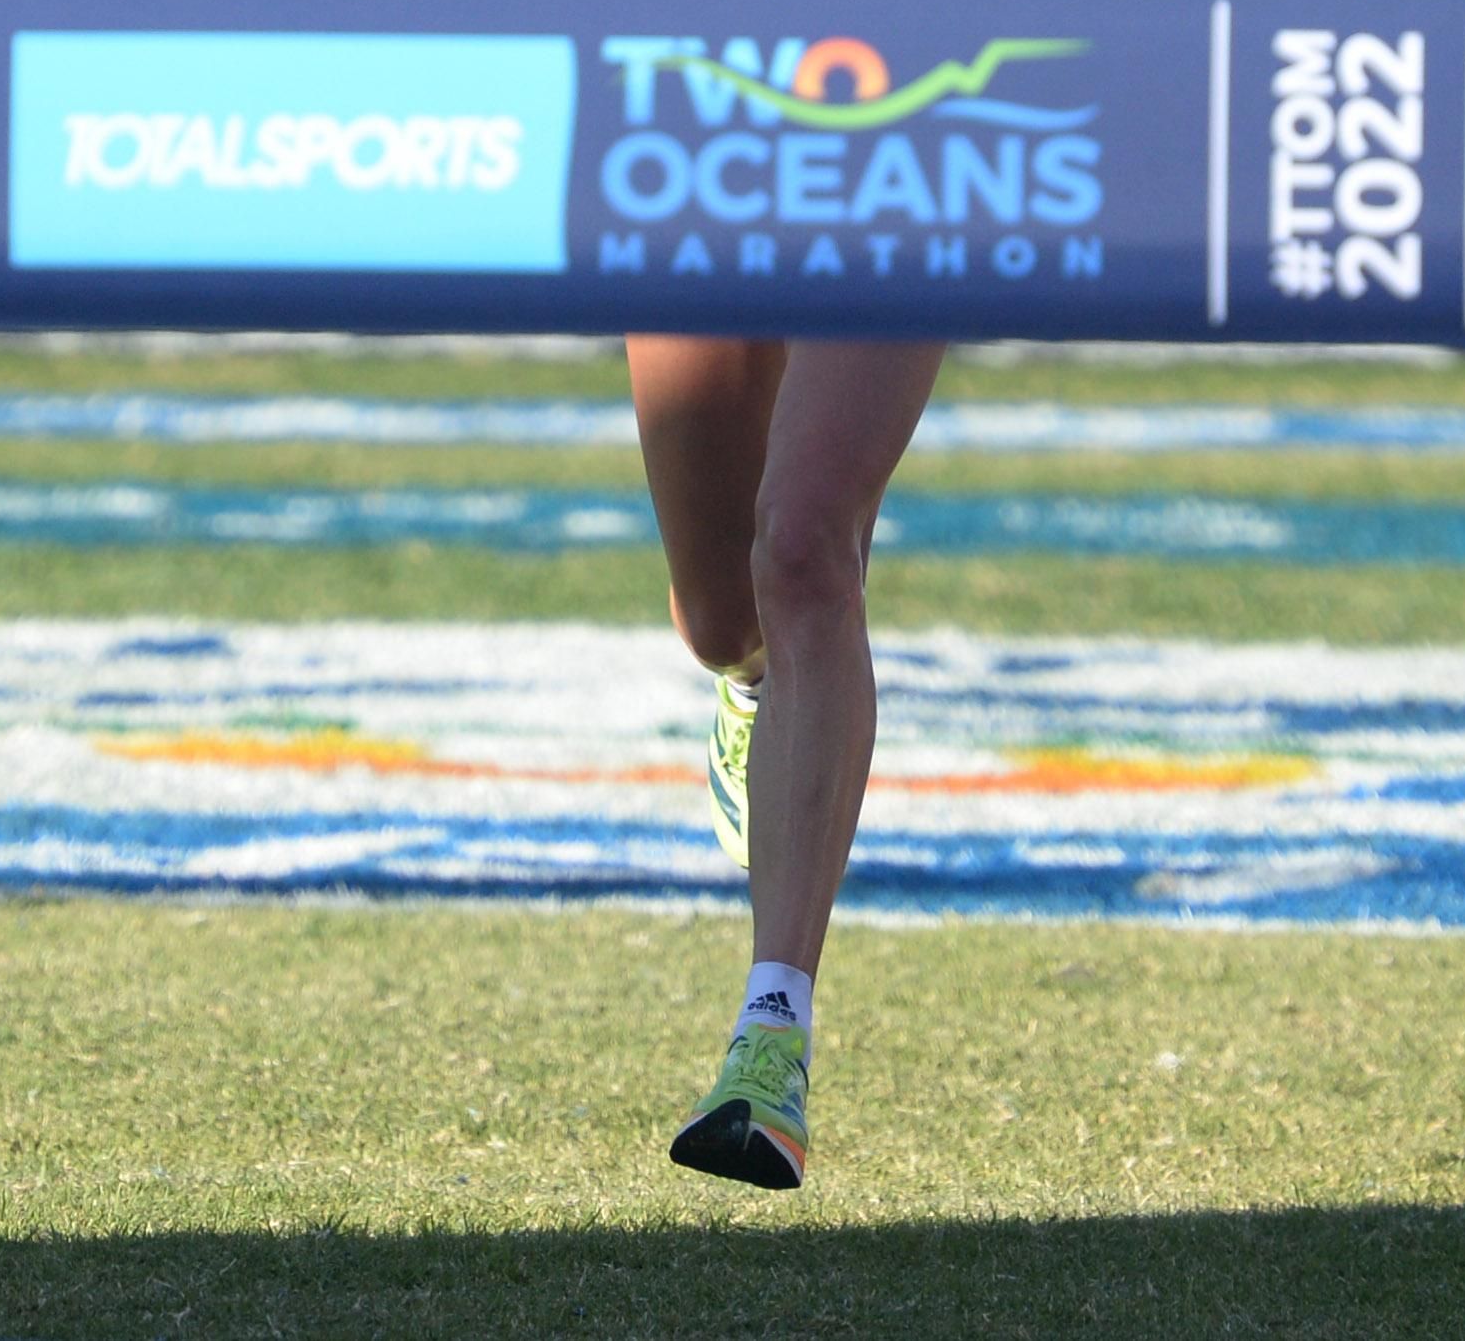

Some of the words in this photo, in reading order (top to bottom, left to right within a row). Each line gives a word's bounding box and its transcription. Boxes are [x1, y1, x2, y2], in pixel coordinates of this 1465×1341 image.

[600, 36, 889, 126] TWO
[63, 113, 523, 190] TOTALSPORTS
[600, 131, 1102, 224] OCEANS
[1270, 29, 1336, 297] #TTOM
[1335, 31, 1424, 299] 2022
[598, 233, 1103, 278] MARATHON
[747, 996, 797, 1021] adidas
